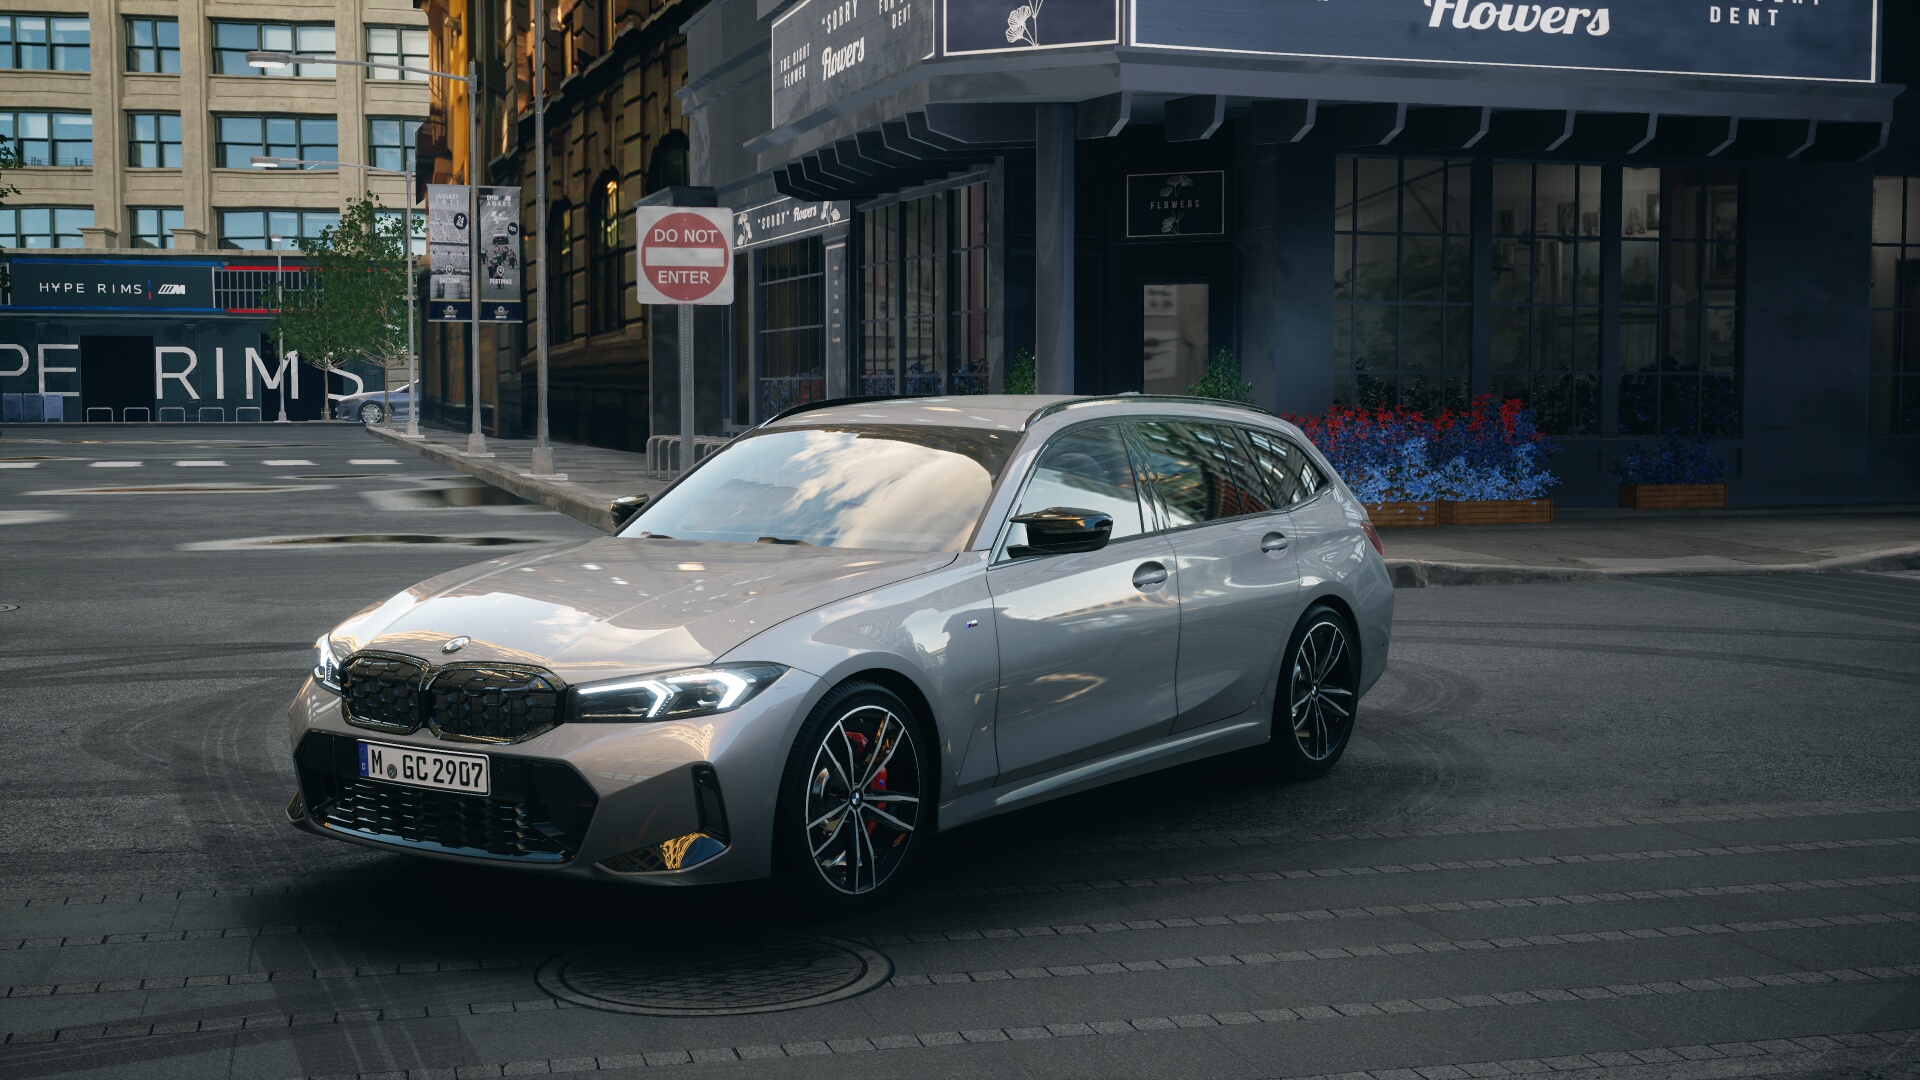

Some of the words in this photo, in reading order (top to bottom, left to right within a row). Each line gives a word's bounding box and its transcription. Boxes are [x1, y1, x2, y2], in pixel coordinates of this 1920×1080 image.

[892, 3, 911, 29] DENT
[1424, 0, 1610, 36] Flowers
[1710, 6, 1778, 26] DENT
[780, 55, 791, 73] THE
[793, 42, 810, 66] RIGHT
[822, 36, 865, 81] Flowers
[784, 64, 806, 88] FLOWER
[793, 206, 817, 222] Flowers
[1150, 200, 1200, 209] FLOWERS
[655, 229, 678, 242] DO
[684, 230, 718, 243] NOT
[39, 282, 85, 293] HYPE
[97, 283, 142, 294] RIMS
[658, 270, 710, 284] ENTER
[371, 749, 383, 775] M
[402, 754, 428, 781] GC
[433, 758, 483, 787] 2907
